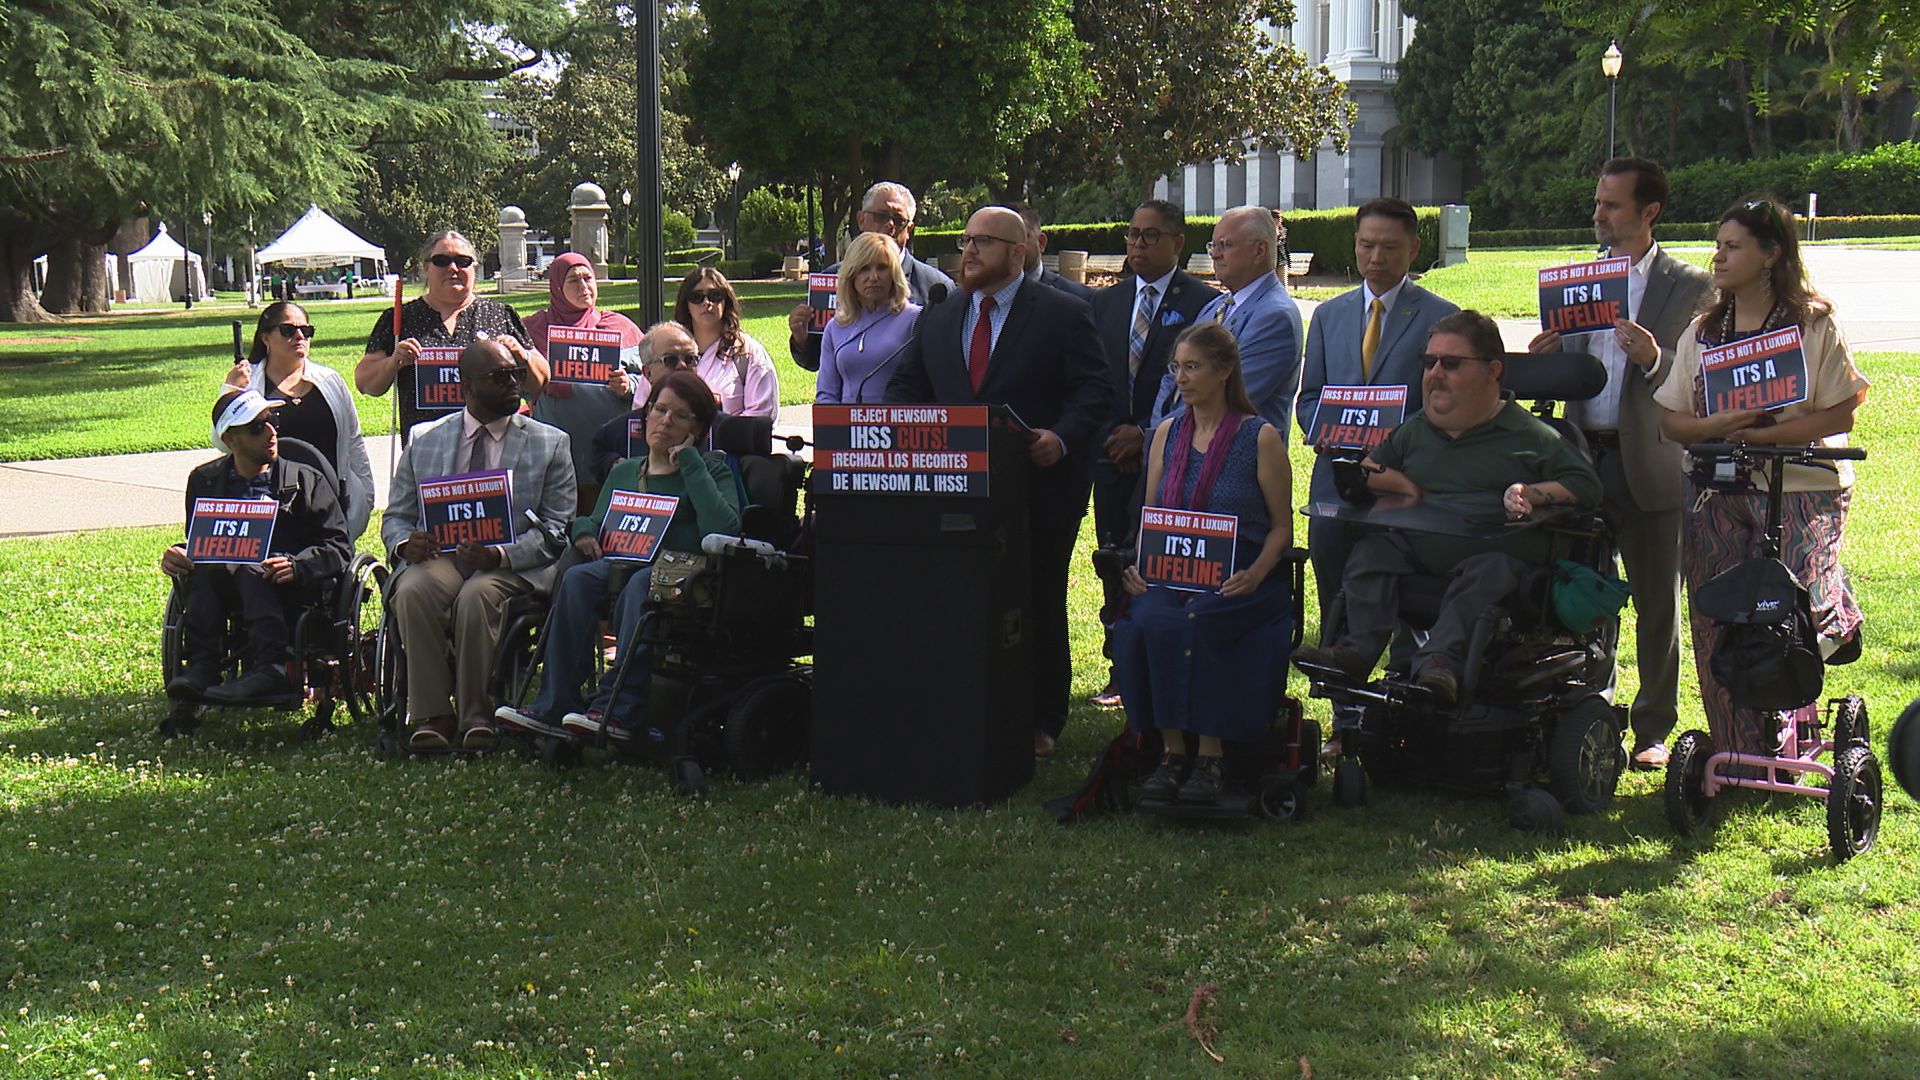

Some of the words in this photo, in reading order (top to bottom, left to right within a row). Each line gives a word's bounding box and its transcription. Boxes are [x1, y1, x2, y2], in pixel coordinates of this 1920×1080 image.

[1540, 272, 1558, 282] IHSS
[1560, 270, 1568, 279] IS
[1570, 268, 1585, 278] NOT
[1588, 266, 1593, 276] A
[1596, 262, 1627, 274] LUXURY
[812, 277, 826, 286] IHSS
[828, 278, 833, 287] IS
[1563, 286, 1588, 305] IT'S
[1592, 284, 1602, 301] A
[1548, 301, 1620, 330] LIFELINE
[551, 330, 565, 338] IHSS
[567, 331, 573, 339] IS
[575, 332, 587, 340] NOT
[589, 333, 593, 341] A
[596, 333, 620, 342] LUXURY
[436, 352, 443, 360] IS
[445, 352, 458, 360] NOT
[569, 346, 588, 361] IT'S
[592, 348, 599, 362] A
[1705, 352, 1724, 366] IHSS
[1727, 350, 1735, 360] IS
[1737, 344, 1753, 357] NOT
[1756, 342, 1762, 352] A
[1764, 332, 1796, 350] LUXURY
[440, 368, 460, 382] IT'S
[1732, 364, 1760, 387] IT'S
[1765, 360, 1776, 379] A
[425, 384, 464, 402] LIFEL
[1324, 390, 1342, 400] IHSS
[1343, 391, 1351, 400] IS
[1353, 391, 1368, 400] NOT
[1368, 391, 1374, 400] A
[1376, 390, 1404, 400] LUXURY
[851, 409, 887, 423] REJECT
[891, 409, 947, 423] NEWSOM'S
[1340, 408, 1367, 426] IT'S
[1368, 410, 1379, 426] A
[851, 426, 892, 449] IHSS
[897, 427, 948, 450] CUTS!
[832, 453, 884, 467] ¡RECHAZA
[888, 454, 909, 467] LOS
[912, 454, 968, 468] RECORTES
[423, 488, 441, 498] IHSS
[442, 487, 450, 496] IS
[452, 485, 466, 495] NOT
[469, 484, 474, 493] A
[475, 481, 503, 492] LUXURY
[833, 474, 848, 490] DE
[852, 474, 910, 491] NEWSOM
[915, 475, 930, 491] AL
[934, 475, 968, 492] IHSS!
[197, 503, 215, 512] IHSS
[216, 504, 223, 512] IS
[225, 504, 240, 512] NOT
[240, 504, 246, 513] A
[247, 505, 275, 514] LUXURY
[448, 503, 472, 521] IT'S
[476, 501, 485, 518] A
[613, 496, 627, 505] IHSS
[627, 497, 633, 506] IS
[635, 498, 647, 508] NOT
[646, 499, 652, 508] A
[652, 500, 675, 511] LUXURY
[213, 520, 237, 536] IT'S
[239, 522, 249, 536] A
[619, 514, 641, 531] IT'S
[639, 518, 651, 532] A
[1144, 512, 1163, 524] IHSS
[1165, 514, 1173, 525] IS
[1175, 516, 1191, 527] NOT
[1193, 518, 1198, 528] A
[1201, 518, 1234, 532] LUXURY
[194, 537, 261, 558] LIFELINE
[602, 531, 656, 555] LIFELINE
[1165, 536, 1192, 556] IT'S
[1195, 539, 1205, 558] A
[1146, 554, 1223, 586] LIFELINE
